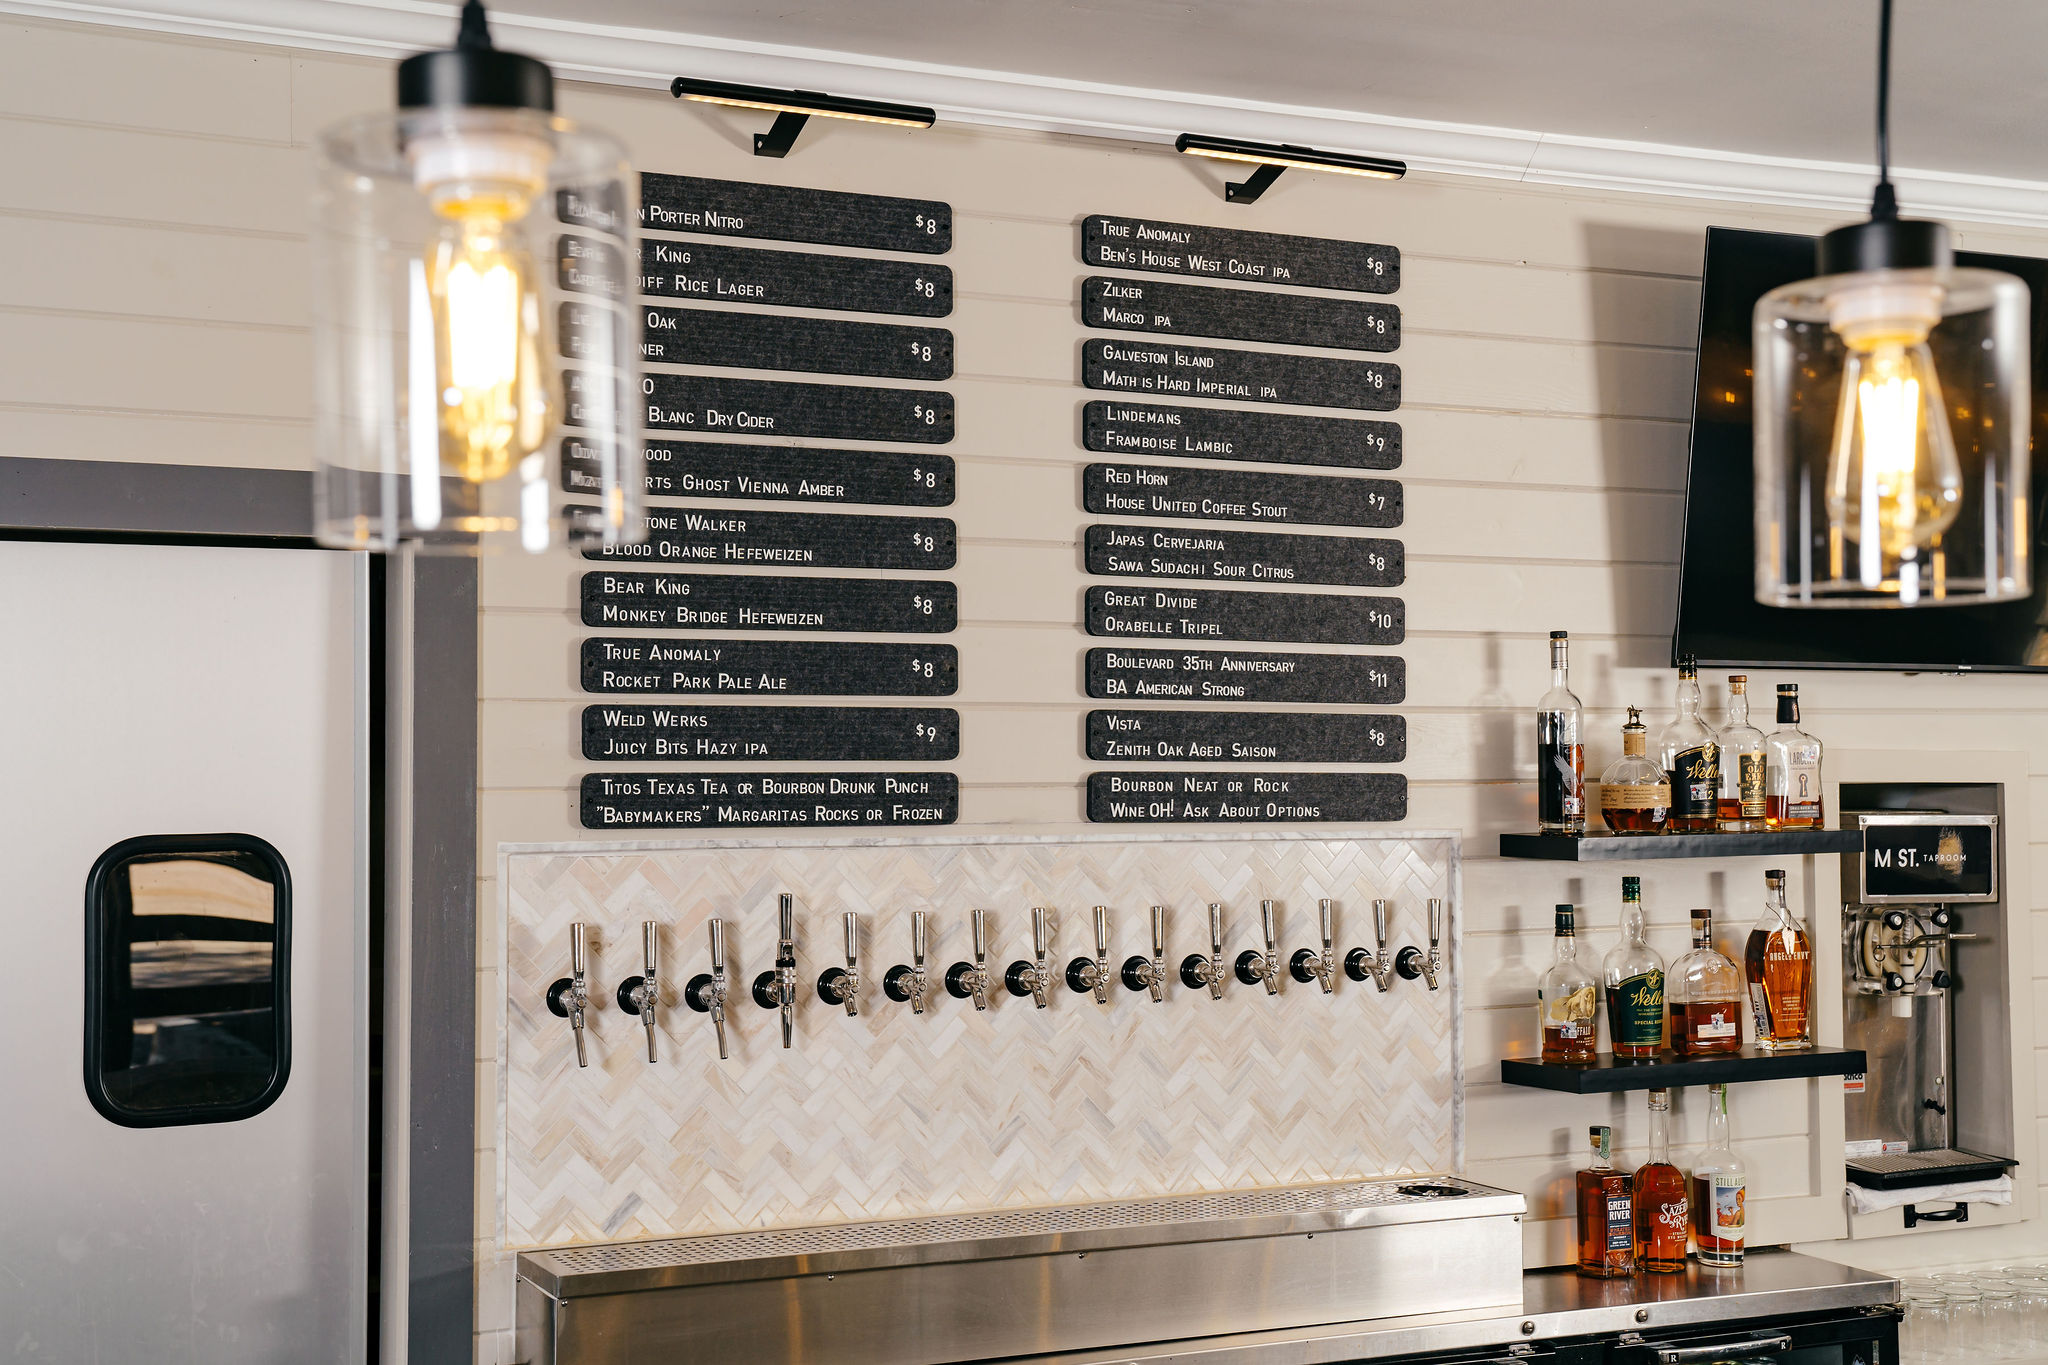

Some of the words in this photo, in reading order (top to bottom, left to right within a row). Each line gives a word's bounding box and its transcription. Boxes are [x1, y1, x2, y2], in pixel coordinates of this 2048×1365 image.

[915, 214, 937, 235] $8
[1366, 256, 1383, 276] $8
[914, 277, 935, 298] $8
[1367, 314, 1385, 334] $8
[911, 341, 932, 362] $8
[1366, 369, 1383, 389] $8
[914, 404, 935, 425] $8
[1366, 433, 1385, 452] $9
[913, 467, 936, 488] $8
[1368, 492, 1385, 511] $7
[913, 532, 934, 552] $8
[1368, 552, 1385, 572] $8
[913, 594, 933, 615] $8
[1368, 609, 1392, 629] $10
[912, 658, 934, 678] $8
[1368, 669, 1387, 688] $11
[915, 723, 937, 743] $9
[1368, 728, 1385, 747] $8
[1874, 849, 1891, 868] M
[1898, 848, 1919, 868] ST.
[1923, 854, 1967, 862] TAPROOM
[1715, 1177, 1733, 1187] STILL
[1608, 1200, 1631, 1211] GREEN
[1609, 1210, 1631, 1221] RIVER
